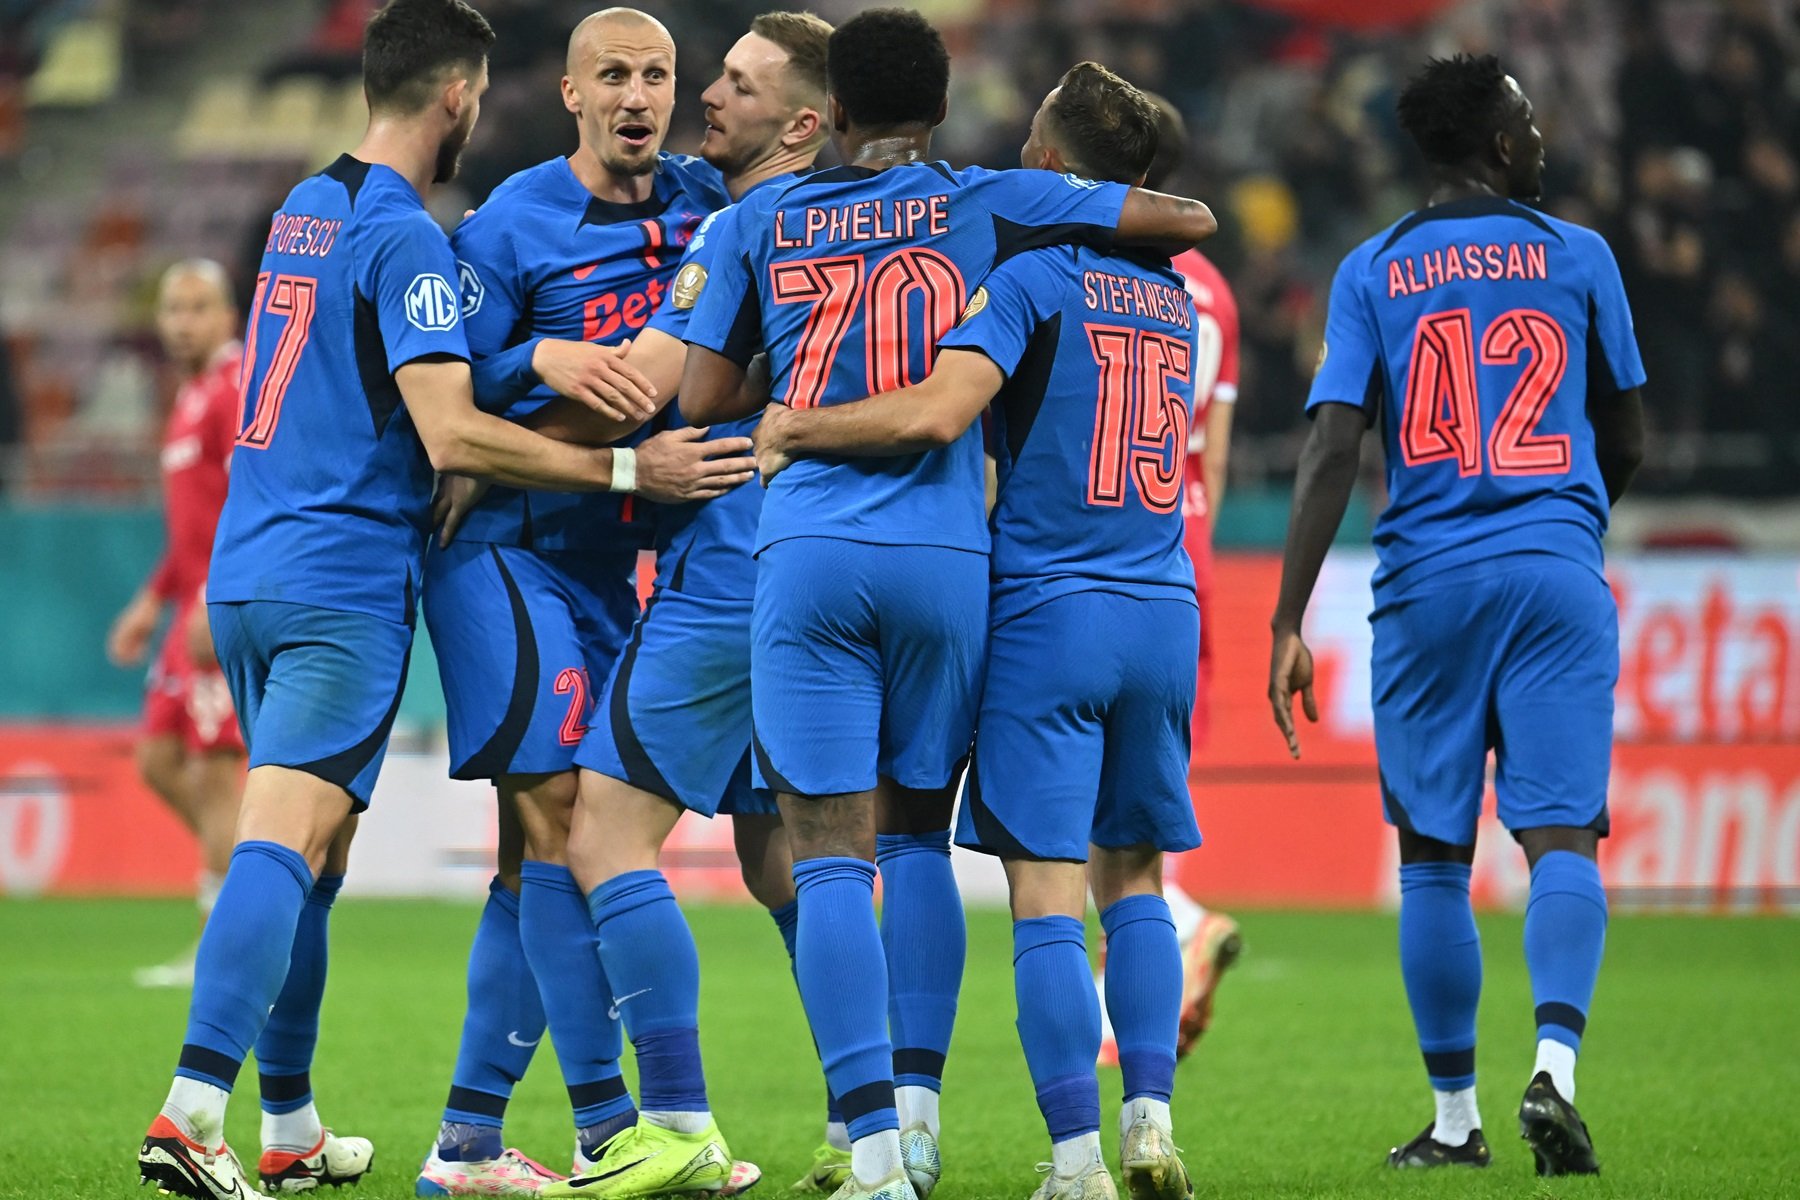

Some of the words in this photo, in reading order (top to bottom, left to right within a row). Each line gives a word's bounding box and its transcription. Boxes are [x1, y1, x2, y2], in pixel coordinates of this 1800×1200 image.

[775, 195, 949, 248] L.PHELIPE
[1083, 271, 1191, 330] STEFANESCU
[1388, 243, 1548, 298] ALHASSAN
[406, 276, 457, 327] MG
[583, 278, 673, 342] Bet
[769, 247, 966, 410] 70
[1083, 322, 1190, 515] 15
[1400, 307, 1571, 478] 42
